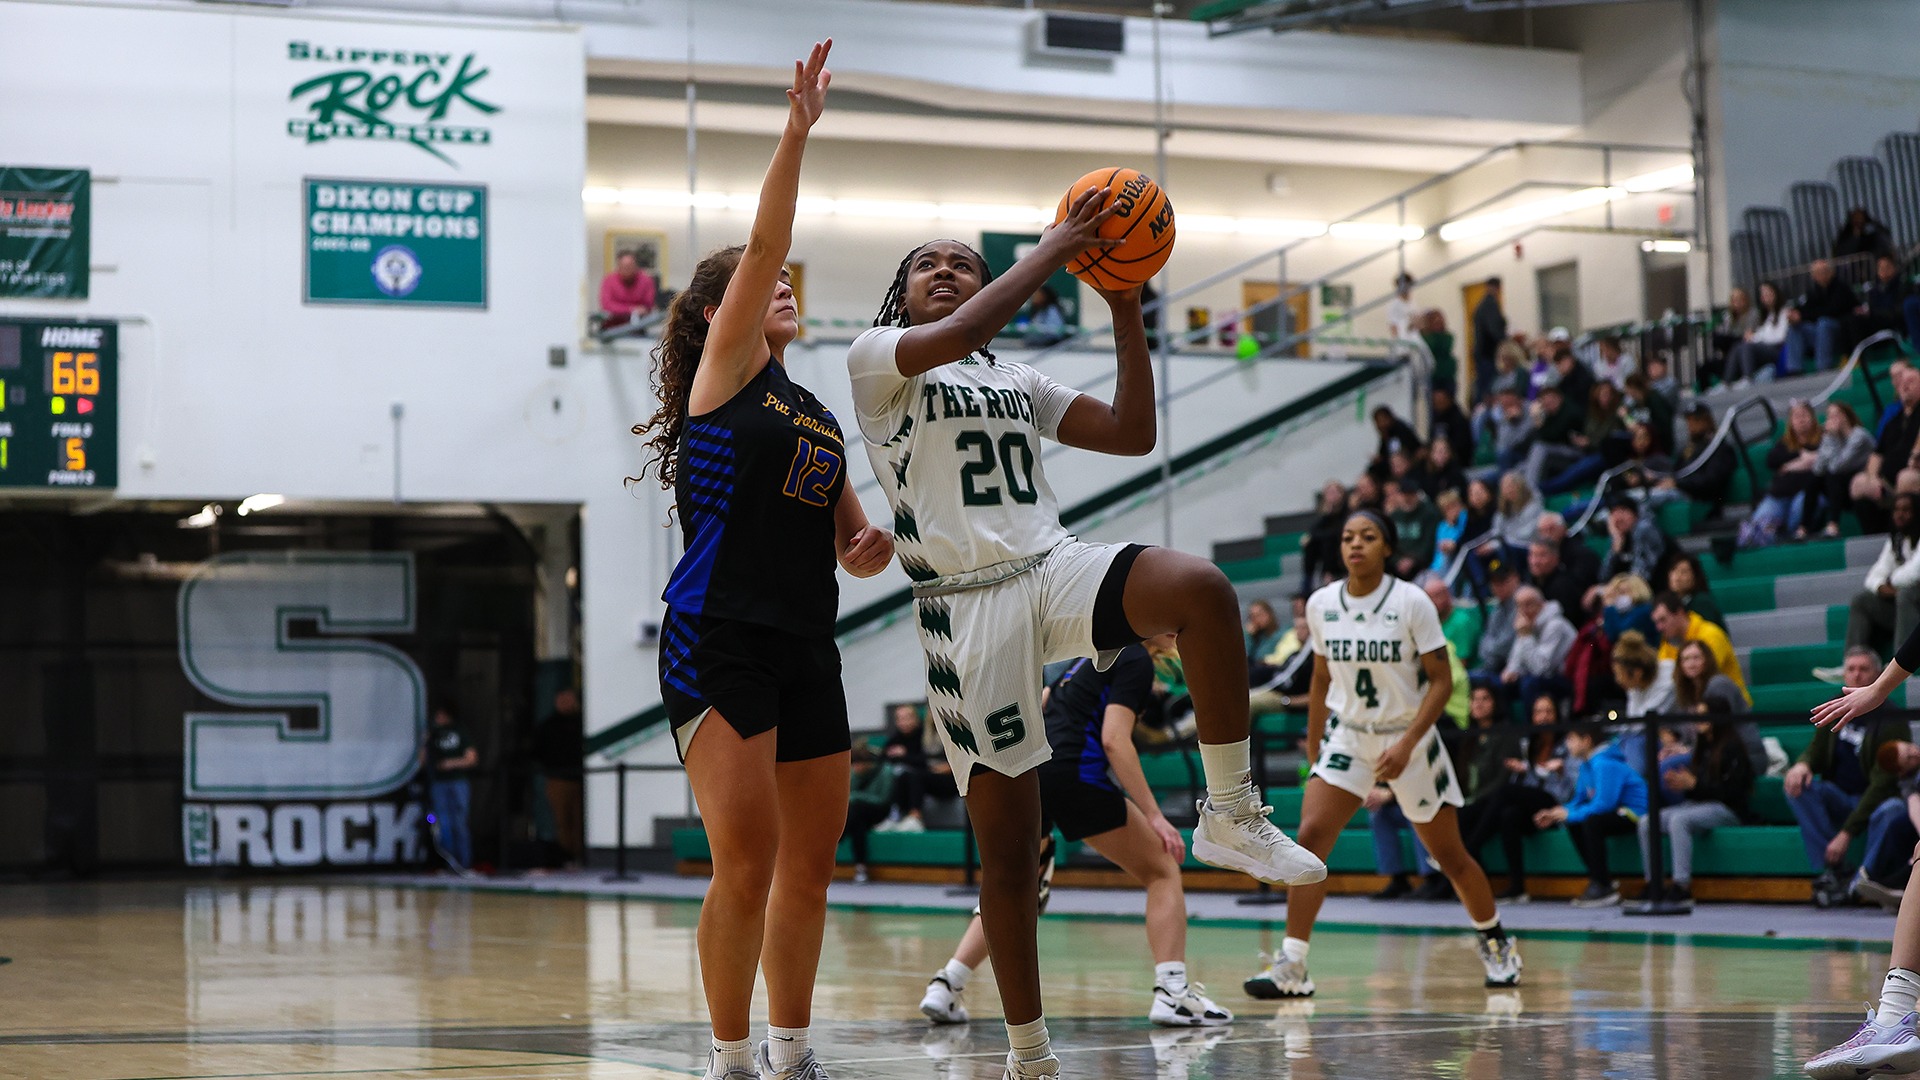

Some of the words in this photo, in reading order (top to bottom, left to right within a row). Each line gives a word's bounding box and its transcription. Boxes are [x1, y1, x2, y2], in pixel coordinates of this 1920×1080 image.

[316, 186, 413, 212] DIXON
[417, 189, 475, 213] CUP
[311, 211, 480, 240] CHAMPIONS
[41, 326, 103, 349] HOME
[52, 352, 99, 395] 66
[924, 381, 982, 423] THE
[51, 422, 94, 439] FOULS
[66, 438, 86, 471] 5
[782, 436, 842, 507] 12
[955, 430, 1038, 507] 20
[1357, 640, 1402, 662] ROCK
[176, 551, 427, 800] S
[1355, 668, 1379, 708] 4
[984, 702, 1026, 753] S
[213, 804, 426, 866] ROCK
